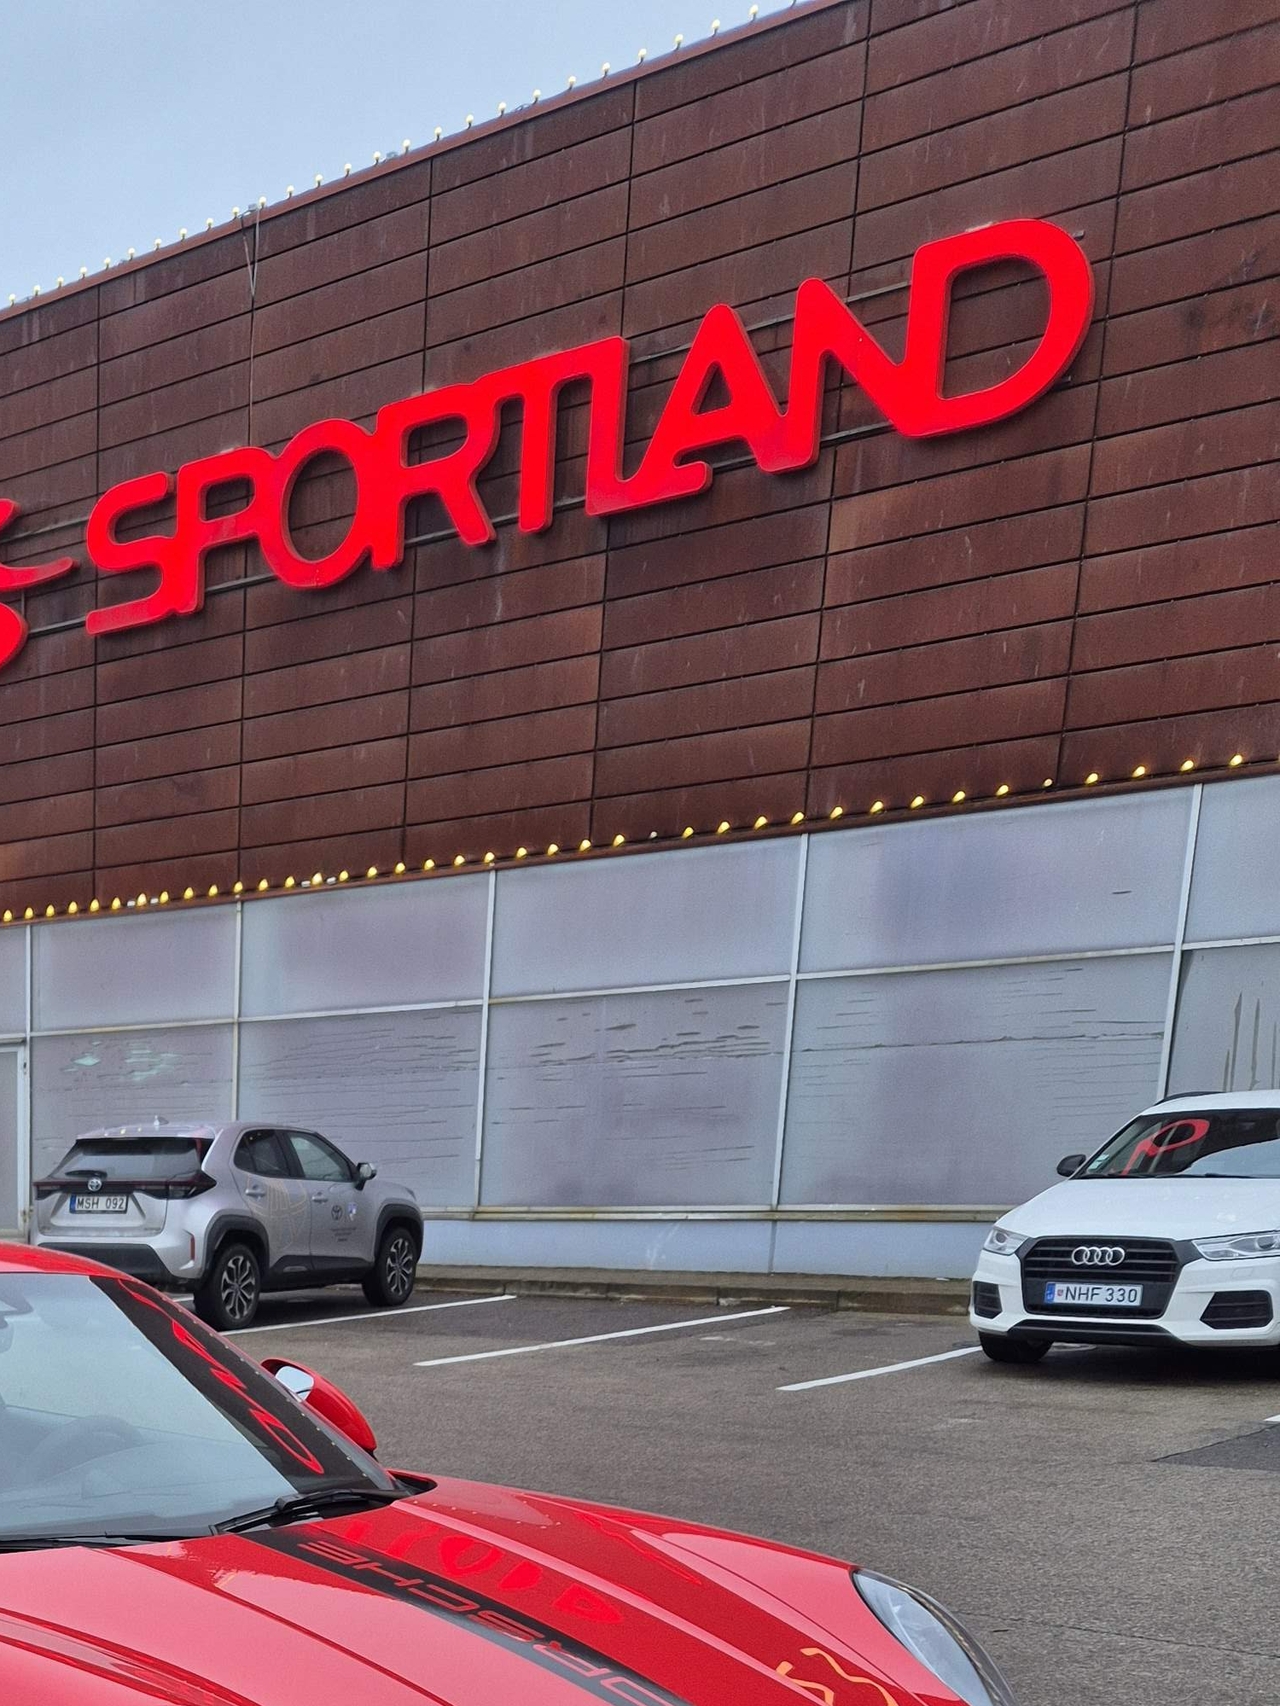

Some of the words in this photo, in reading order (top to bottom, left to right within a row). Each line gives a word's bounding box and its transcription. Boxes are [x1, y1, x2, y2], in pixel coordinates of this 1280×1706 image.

[85, 218, 1096, 637] SPORTLAND
[77, 1197, 99, 1209] MSH
[106, 1198, 124, 1209] 092
[1065, 1286, 1103, 1301] NHF
[1105, 1287, 1138, 1303] 330
